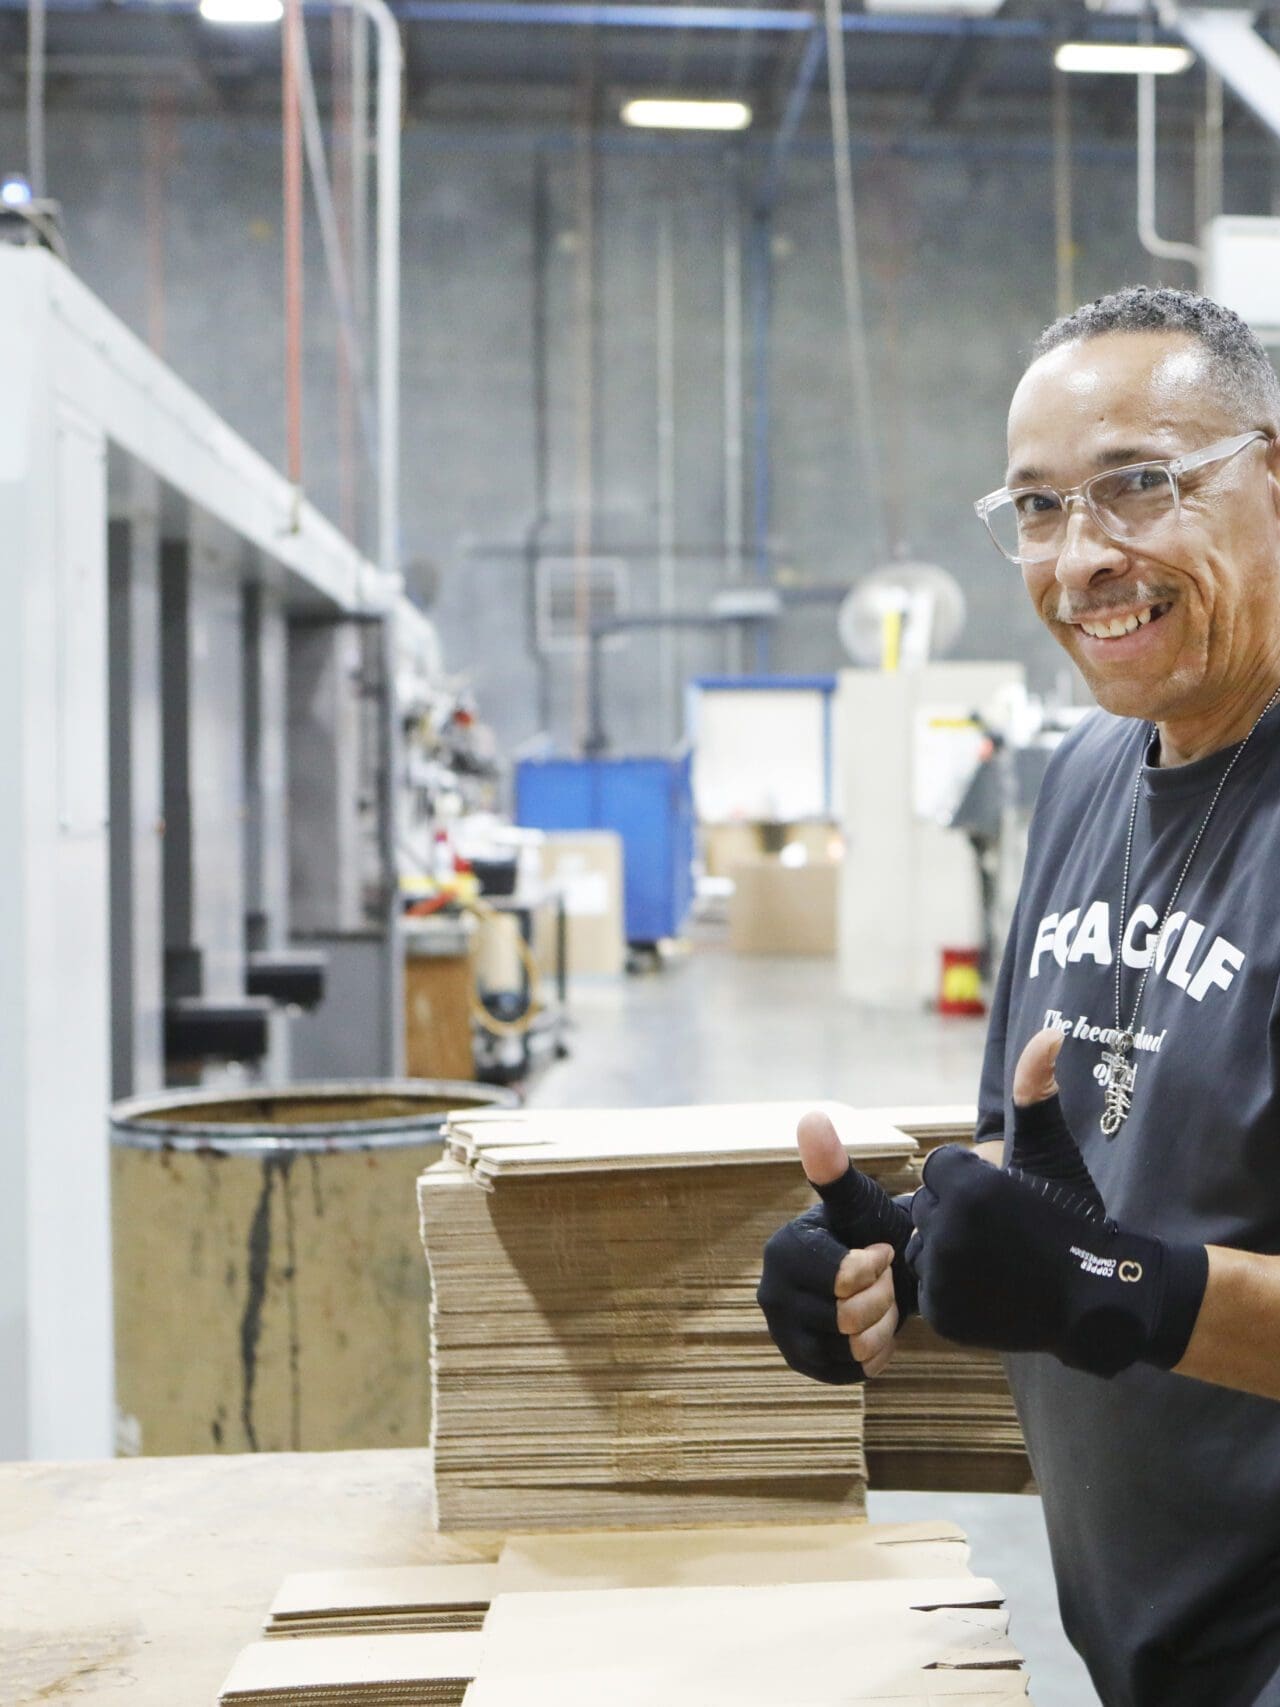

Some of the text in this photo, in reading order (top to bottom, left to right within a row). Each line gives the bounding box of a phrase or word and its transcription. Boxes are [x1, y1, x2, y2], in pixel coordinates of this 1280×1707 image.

[1043, 1009, 1073, 1036] The
[1072, 1015, 1133, 1047] hea
[1080, 1260, 1114, 1277] COPPER
